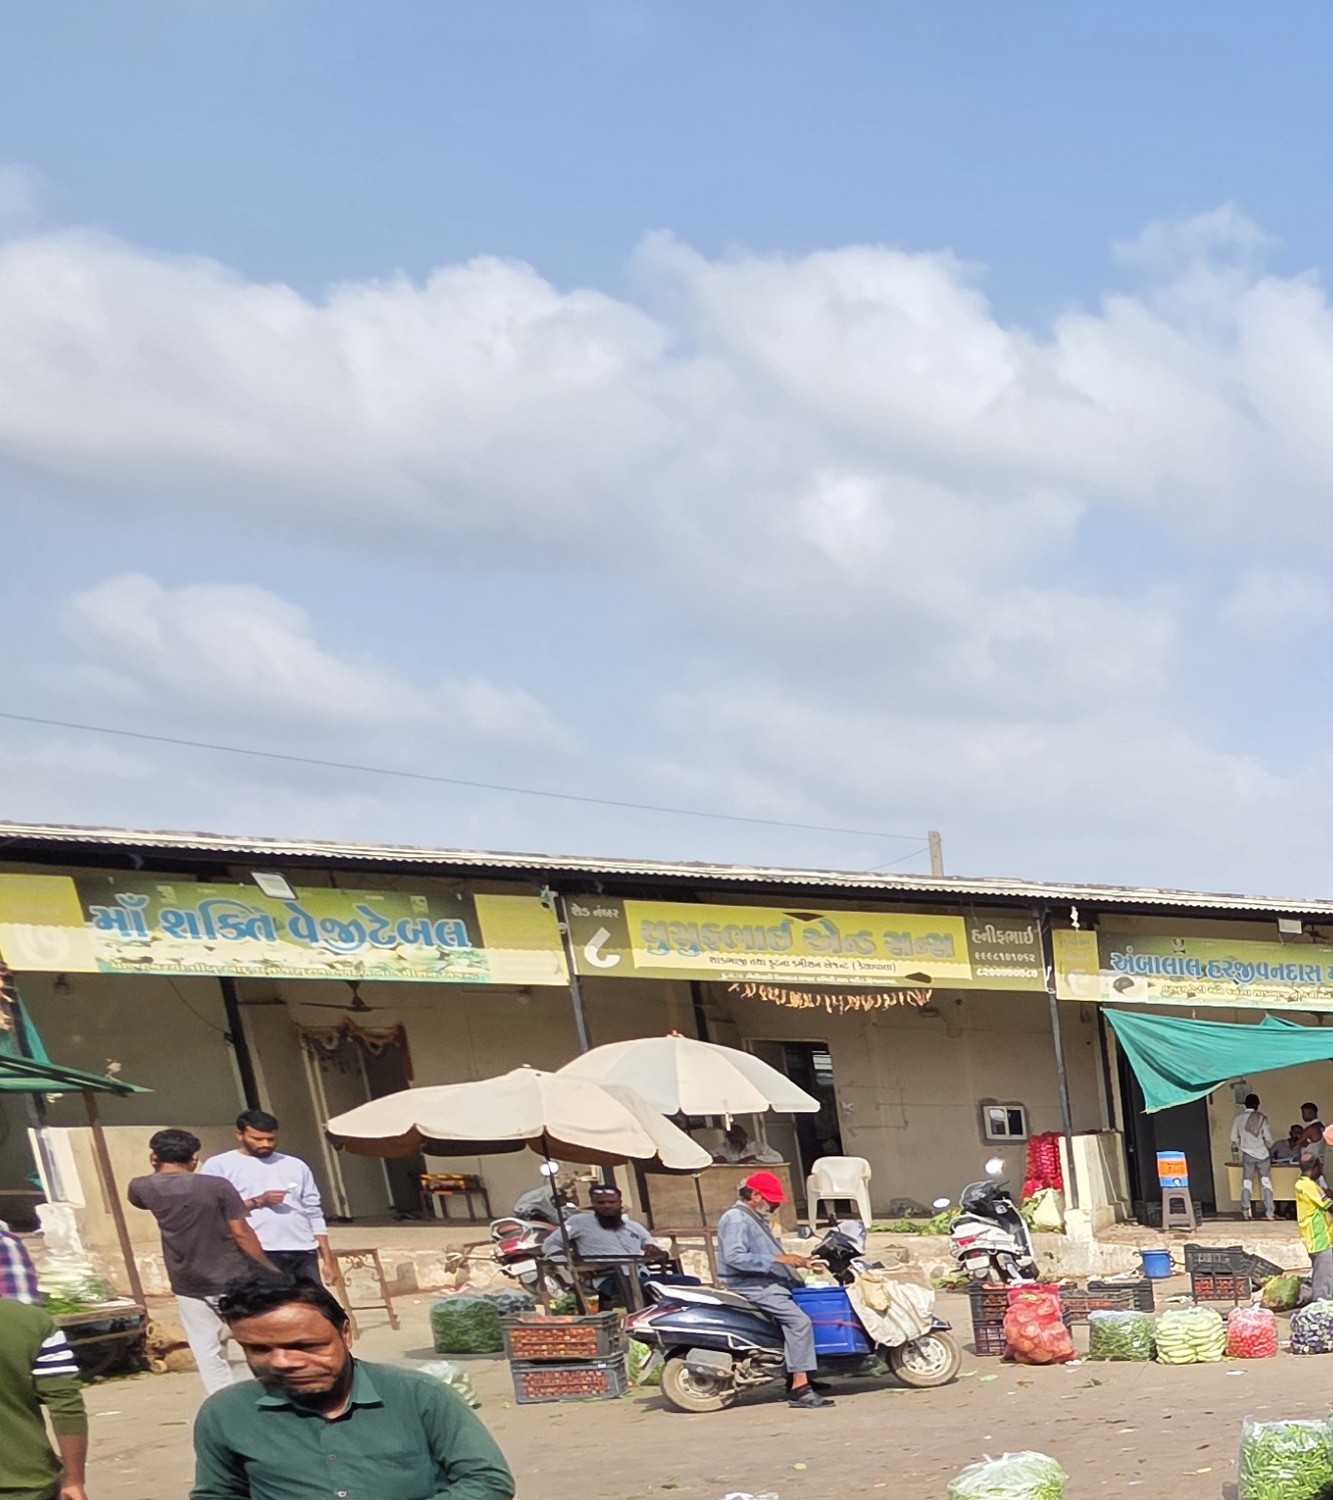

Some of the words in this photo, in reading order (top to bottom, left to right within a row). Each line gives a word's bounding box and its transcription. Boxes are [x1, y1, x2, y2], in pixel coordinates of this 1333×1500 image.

[158, 898, 277, 942] શક્તિ
[283, 901, 472, 956] વેજીટેબલ
[592, 906, 620, 919] નંબર
[801, 918, 877, 956] એન્ડ
[882, 930, 954, 959] સન્સ
[971, 924, 1034, 945] હનીફભાઈ
[1110, 945, 1202, 977] અંબાલાલ
[1205, 957, 1322, 985] હરજીવનદાસ
